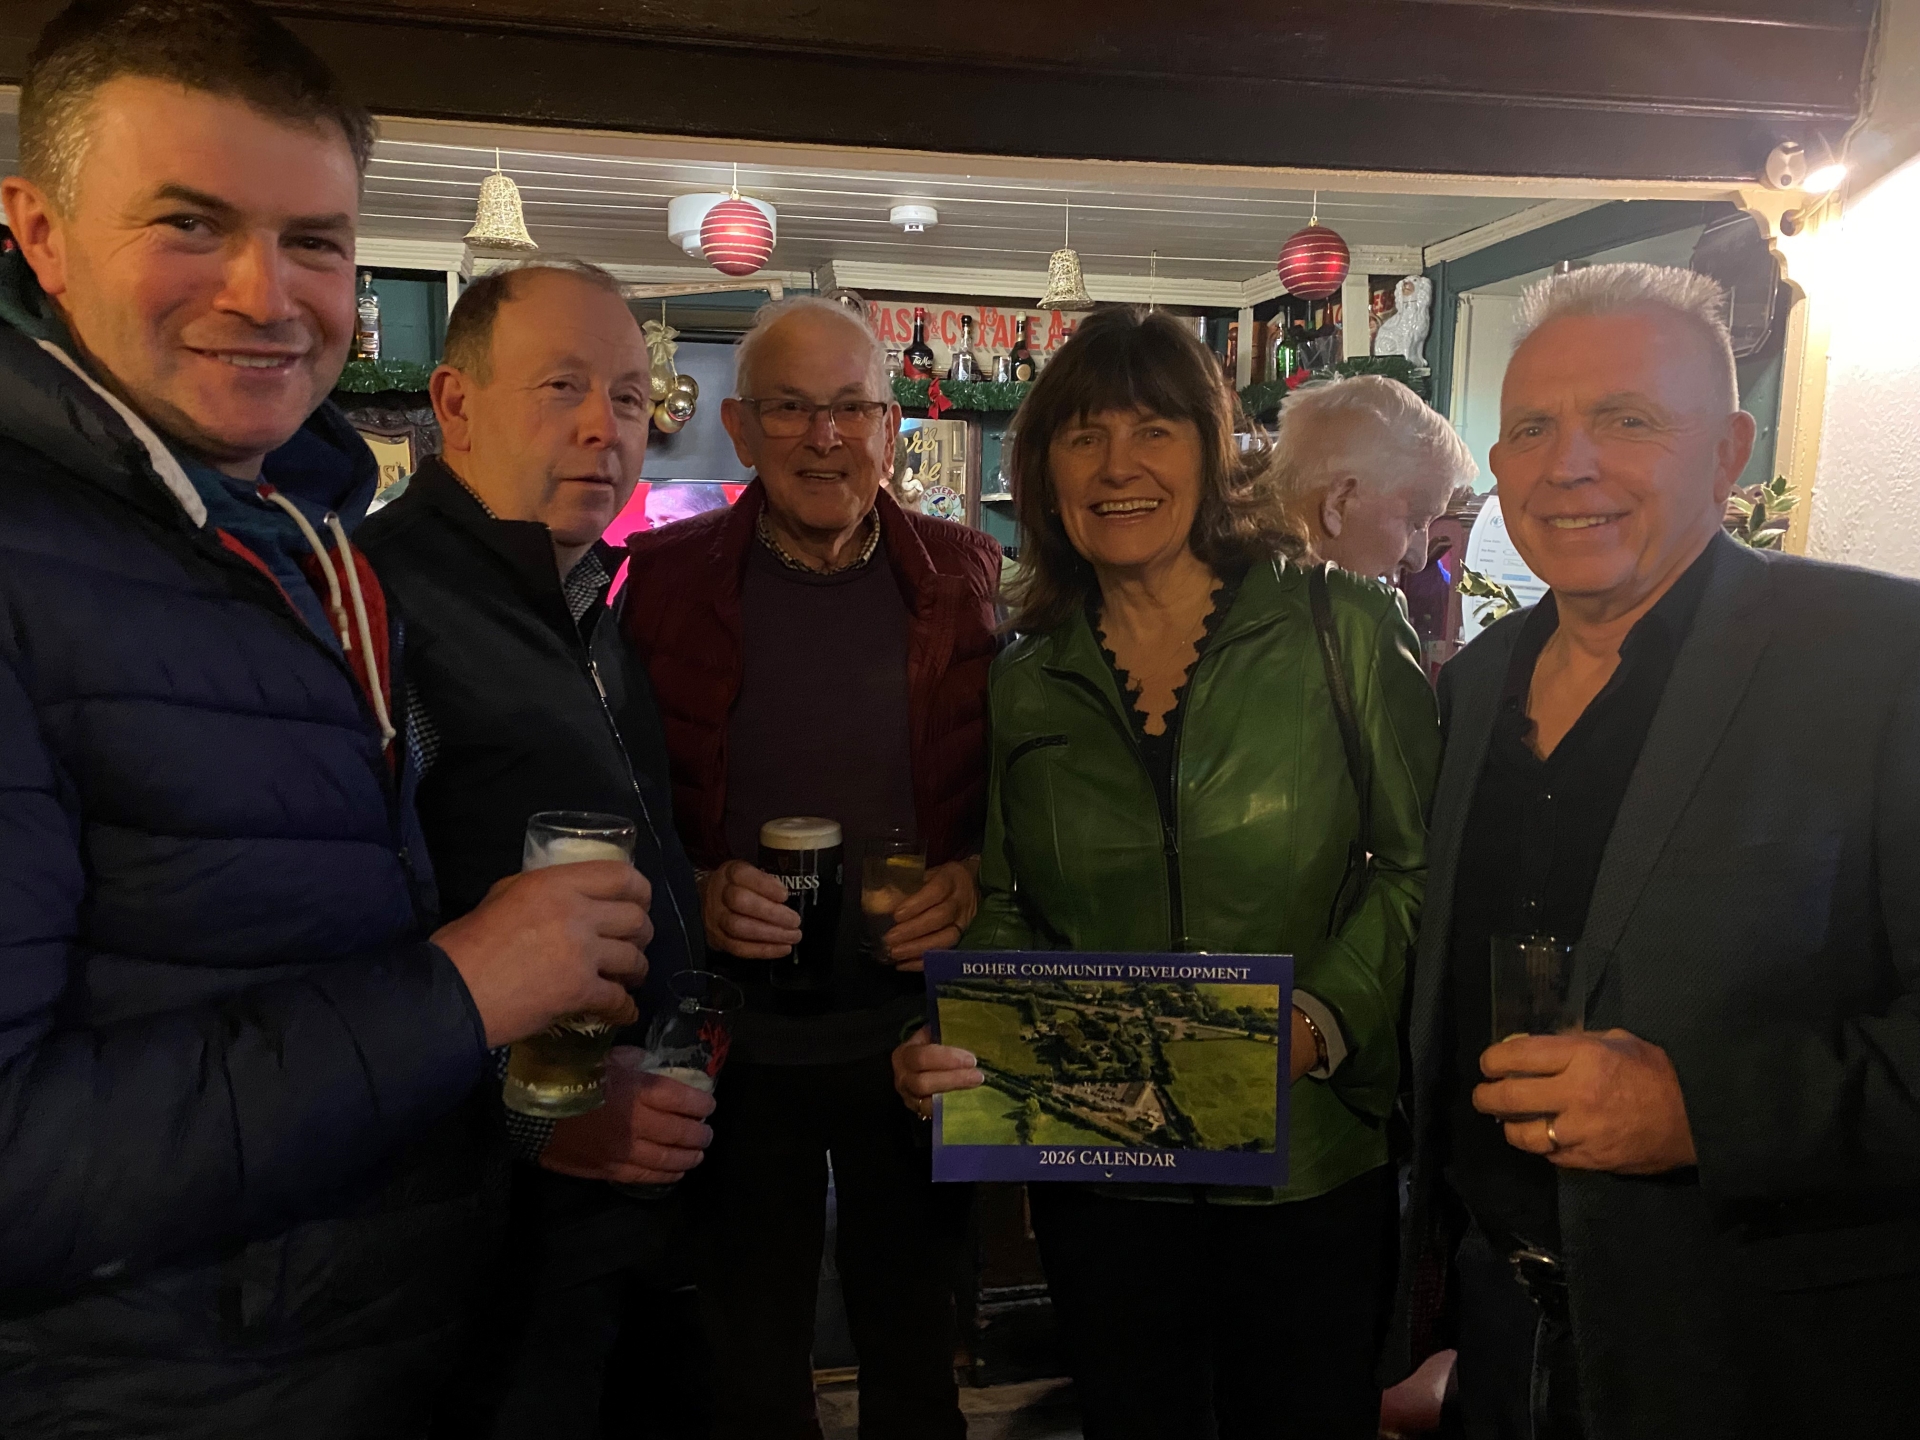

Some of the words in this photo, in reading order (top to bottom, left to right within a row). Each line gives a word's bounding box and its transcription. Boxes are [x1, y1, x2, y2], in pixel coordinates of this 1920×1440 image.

[962, 963, 1016, 975] BOHER
[1020, 963, 1124, 977] COMMUNITY
[1128, 966, 1251, 980] DEVELOPMENT
[1039, 1151, 1075, 1165] 2026
[1079, 1150, 1177, 1167] CALENDAR
